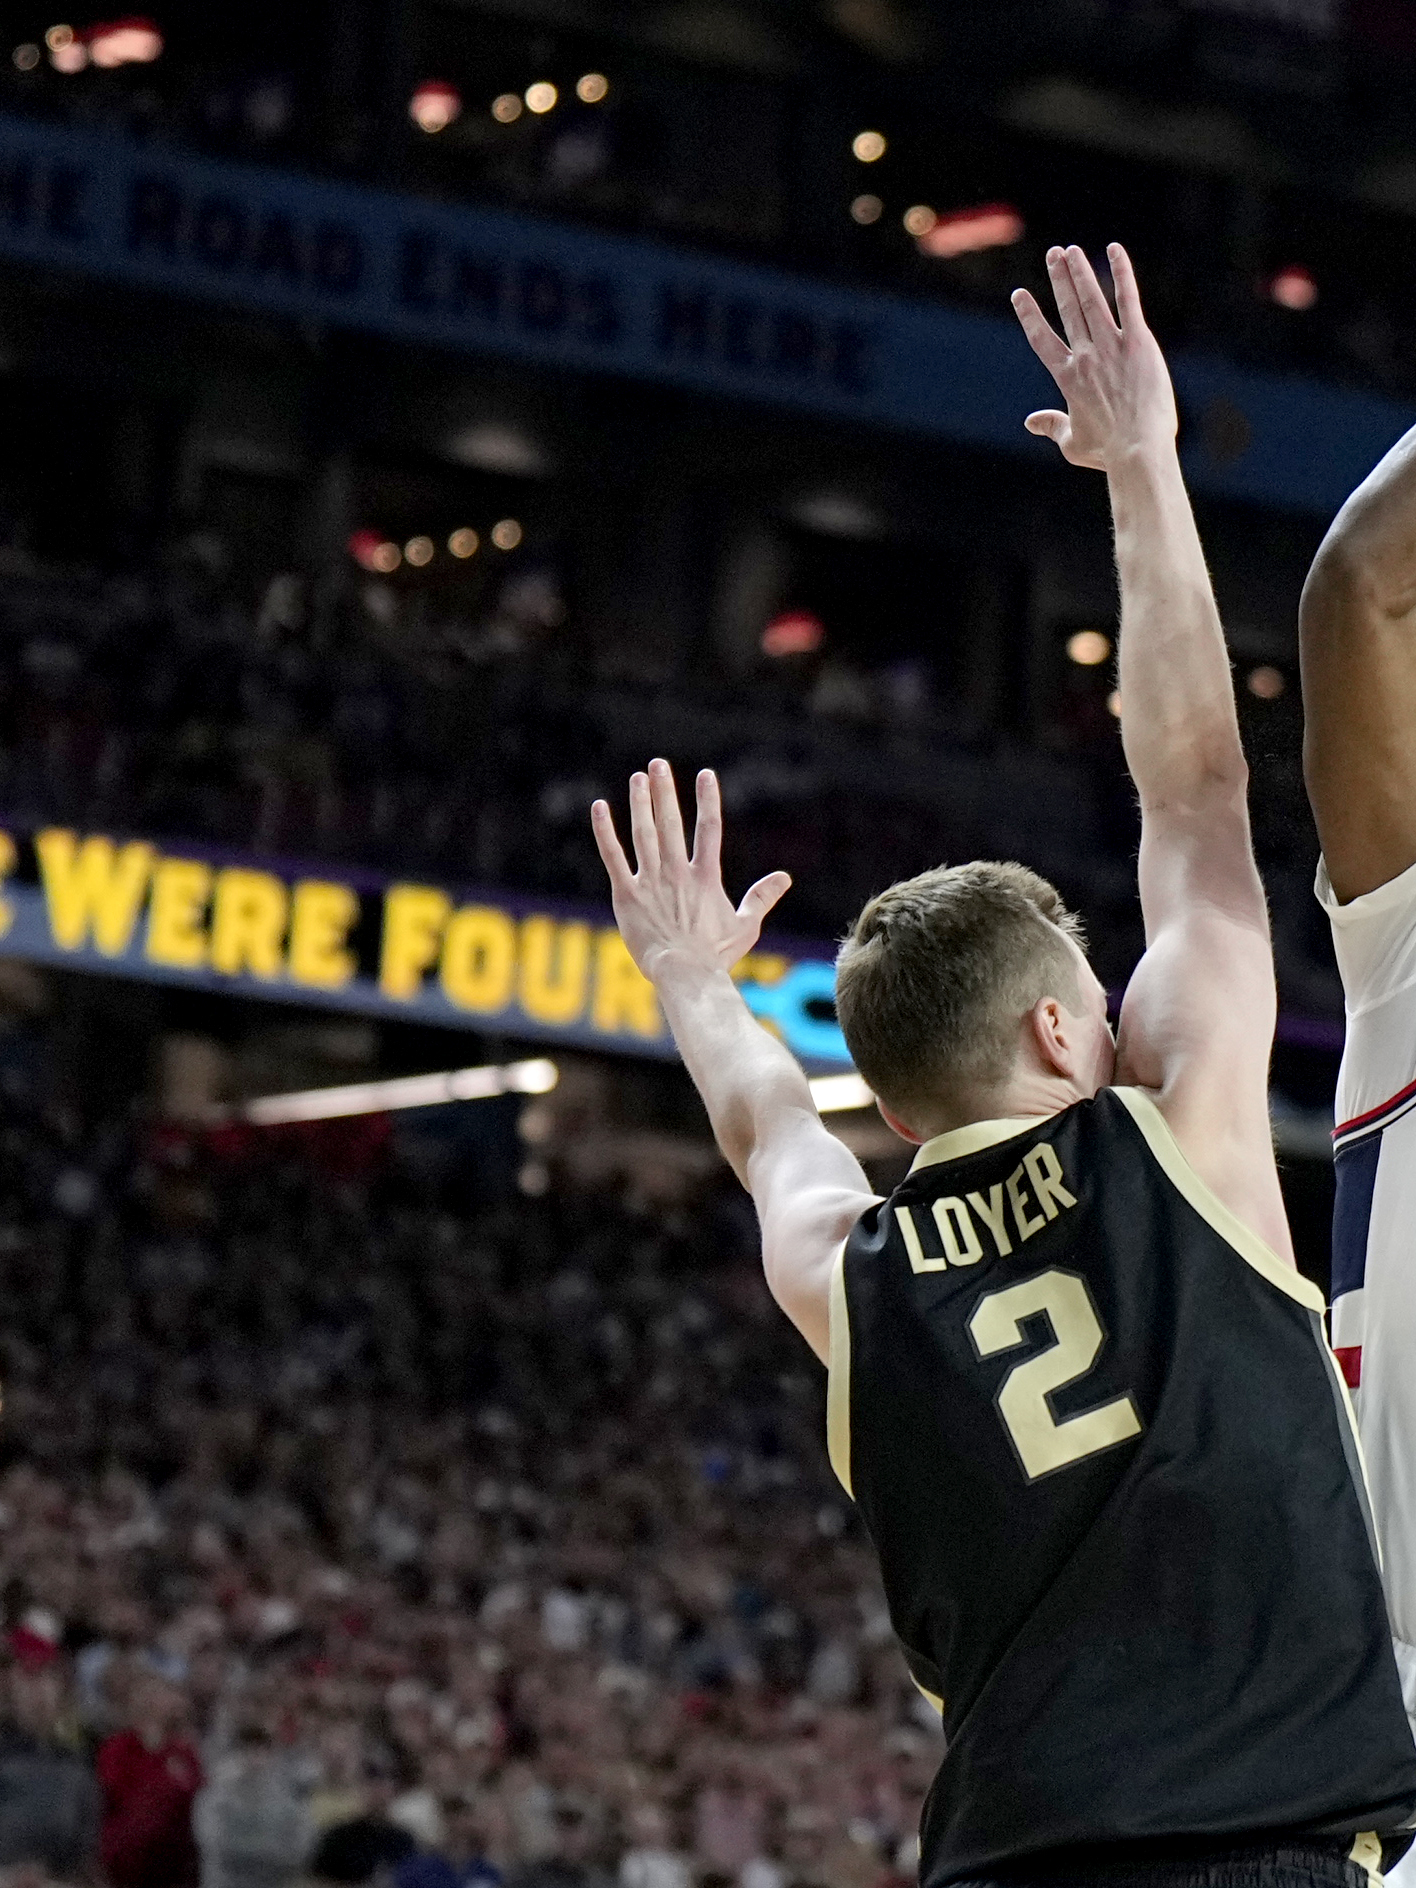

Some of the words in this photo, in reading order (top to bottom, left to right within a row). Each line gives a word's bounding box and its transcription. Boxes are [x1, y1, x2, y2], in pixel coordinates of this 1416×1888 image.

[126, 172, 366, 296] ROAD
[894, 1142, 1077, 1274] LOYER
[967, 1268, 1143, 1480] 2
